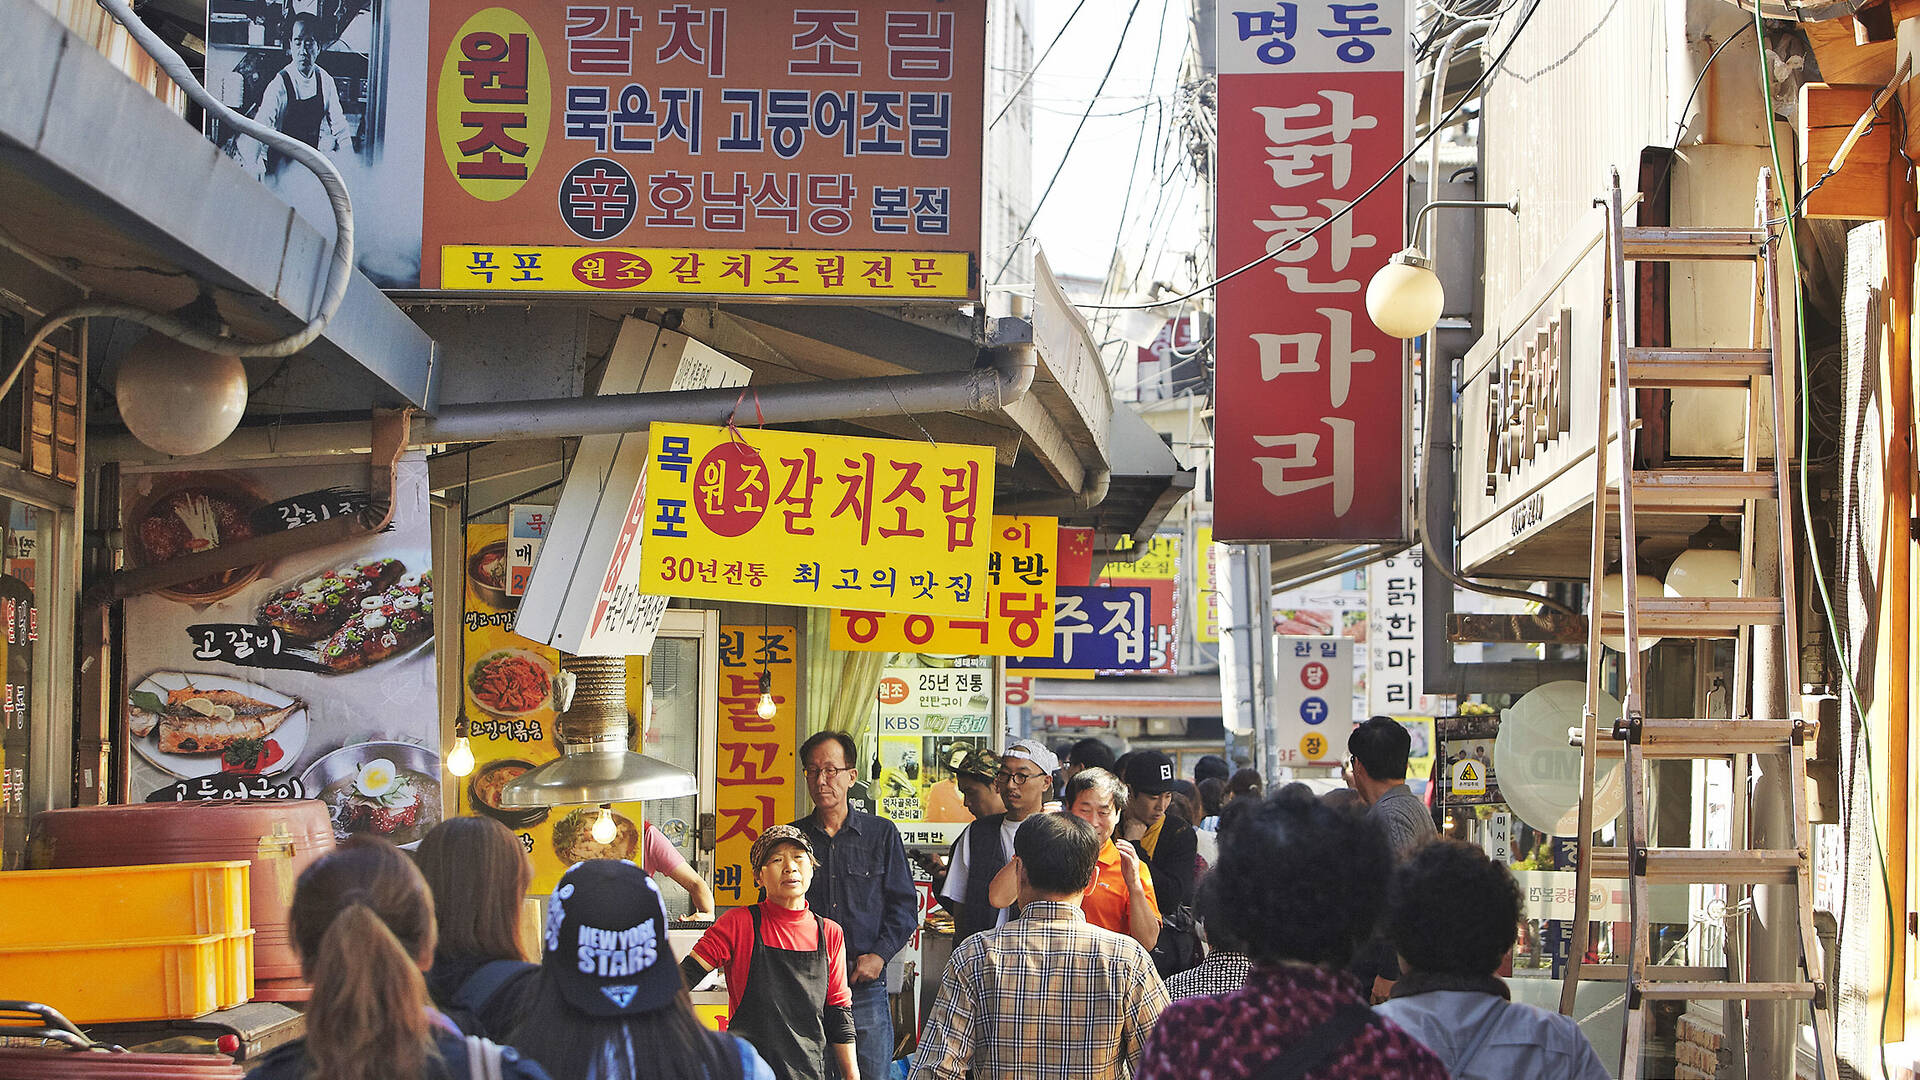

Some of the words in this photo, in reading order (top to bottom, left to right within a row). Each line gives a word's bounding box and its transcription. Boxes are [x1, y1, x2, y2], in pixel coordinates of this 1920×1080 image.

[565, 5, 727, 78] 갈치
[788, 9, 955, 81] 조림
[1232, 2, 1392, 65] 명동
[456, 30, 528, 180] 원조
[563, 84, 701, 155] 묵은지
[717, 88, 952, 159] 고등어조림
[571, 167, 627, 233] 辛
[645, 170, 857, 235] 호남식당
[870, 185, 950, 235] 본점
[466, 252, 543, 283] 목포
[578, 258, 649, 283] 원조
[1249, 89, 1378, 518] 닭한마리
[652, 436, 693, 539] 목포
[699, 458, 767, 516] 원조
[774, 447, 981, 552] 갈치조림
[278, 502, 331, 530] 갈치
[661, 555, 768, 589] 30년전통
[465, 610, 517, 632] 생고기김
[1054, 591, 1145, 665] 주집
[196, 629, 282, 659] 고갈비
[719, 630, 792, 667] 원조
[1294, 641, 1337, 658] 한일
[1386, 576, 1416, 710] 닭한마리
[879, 681, 904, 699] 원조
[919, 674, 949, 692] 25년
[955, 674, 983, 692] 전통
[885, 716, 920, 731] KBS
[1304, 665, 1325, 756] 당구장
[470, 719, 544, 742] 오징어볶음
[1278, 749, 1297, 761] 3F
[899, 831, 944, 844] 개백반
[578, 924, 617, 951] NEW
[617, 917, 657, 950] YORK
[577, 940, 658, 977] STARS
